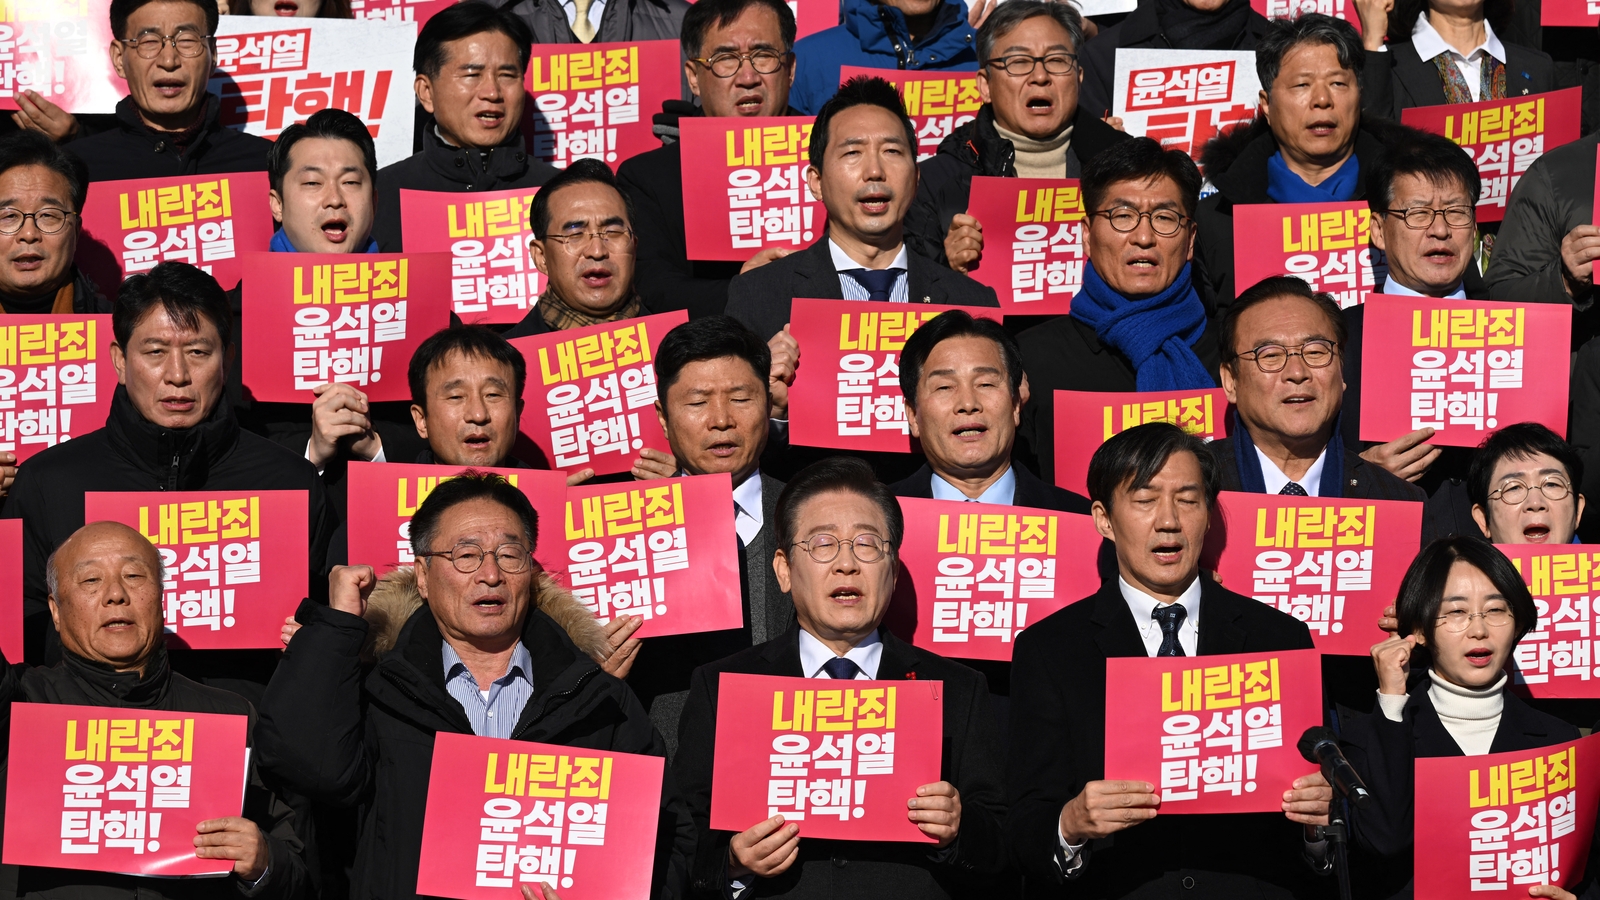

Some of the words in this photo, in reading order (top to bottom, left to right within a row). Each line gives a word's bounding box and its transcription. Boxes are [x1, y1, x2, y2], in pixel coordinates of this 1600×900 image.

[216, 33, 306, 73] 윤석열
[532, 46, 639, 92] 내란죄
[533, 85, 639, 132] 윤석열
[1132, 65, 1230, 107] 윤석열
[1445, 98, 1545, 146] 내란죄
[533, 128, 617, 169] 탄핵!
[1460, 134, 1544, 175] 석열
[119, 178, 232, 230] 내란죄
[122, 220, 236, 272] 윤석열
[729, 206, 814, 249] 탄핵!
[293, 258, 408, 305] 내란죄
[451, 272, 539, 314] 탄핵!
[292, 300, 407, 349] 윤석열
[839, 311, 944, 352] 내란
[1411, 307, 1525, 348] 내란죄
[293, 346, 383, 391] 탄핵!
[538, 322, 651, 386] 내란죄
[1410, 349, 1524, 390] 윤석열
[546, 363, 658, 429] 윤석열
[1410, 391, 1499, 431] 탄핵!
[550, 413, 644, 469] 탄핵!
[139, 496, 260, 545] 내란죄
[565, 482, 685, 541] 내란죄
[1255, 505, 1376, 549] 내란죄
[567, 527, 690, 588] 윤석열
[937, 514, 1058, 556] 내란죄
[934, 556, 1056, 599] 윤석열
[1252, 549, 1373, 592] 윤석열
[1511, 552, 1600, 597] 내란
[571, 577, 668, 627] 탄핵!
[932, 600, 1029, 643] 탄핵!
[1161, 657, 1281, 713] 내란죄
[772, 686, 897, 732] 내란죄
[1160, 703, 1283, 760] 윤석열
[65, 718, 195, 762] 내란죄
[769, 732, 896, 777] 윤석열
[62, 764, 192, 809] 윤석열
[484, 752, 614, 800] 내란죄
[1160, 754, 1258, 803] 탄핵!
[1469, 746, 1576, 809] 내란죄
[480, 797, 609, 846] 윤석열
[767, 778, 867, 821] 탄핵!
[1468, 790, 1576, 852] 윤석열
[60, 810, 162, 855] 탄핵!
[475, 843, 577, 890] 탄핵!
[1469, 842, 1561, 892] 탄핵!
